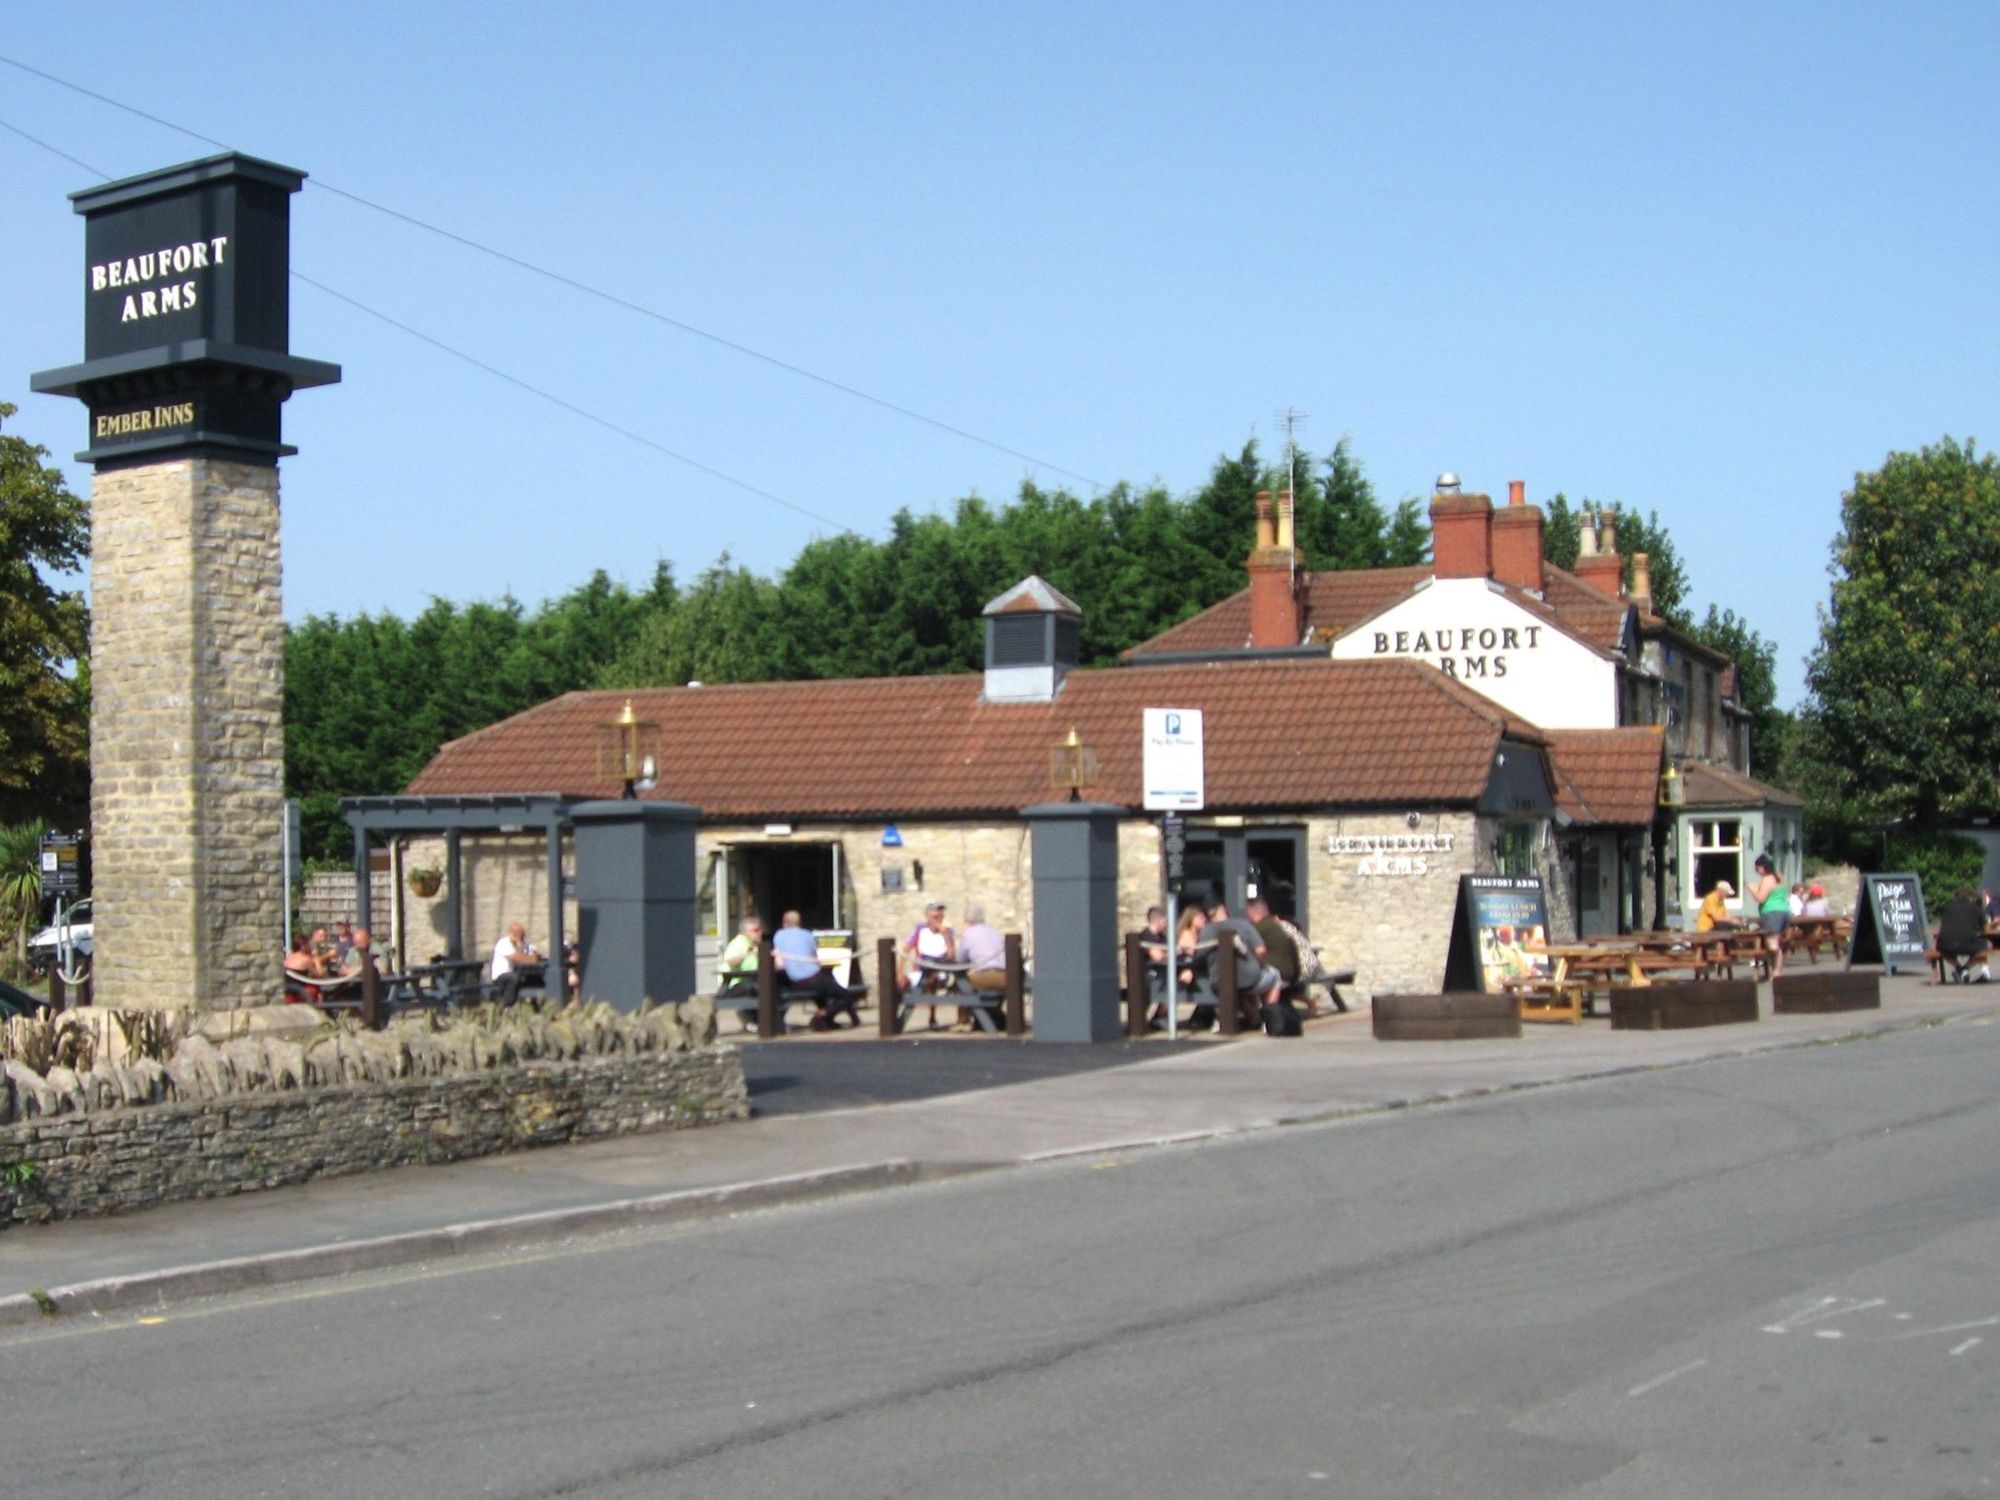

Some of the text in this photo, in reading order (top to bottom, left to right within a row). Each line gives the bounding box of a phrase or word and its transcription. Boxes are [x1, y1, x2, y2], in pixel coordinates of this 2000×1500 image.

[92, 236, 228, 291] BEAUFORT
[121, 281, 198, 323] ARMS
[96, 402, 194, 437] EMBER INNS
[1373, 626, 1542, 654] BEAUFORT
[1328, 834, 1454, 854] BEAUFORT
[1357, 853, 1428, 876] ARMS
